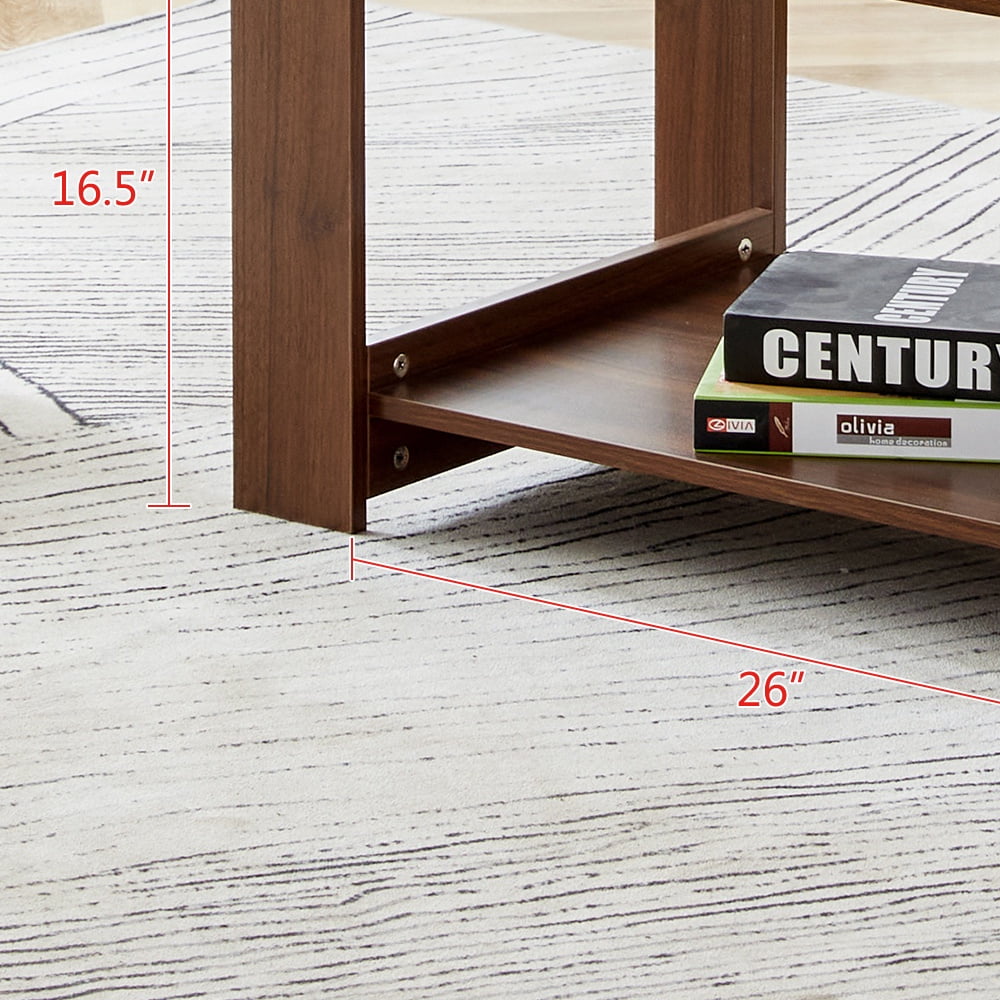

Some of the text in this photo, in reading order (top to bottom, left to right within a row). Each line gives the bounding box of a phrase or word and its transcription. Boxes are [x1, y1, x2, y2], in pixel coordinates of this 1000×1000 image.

[873, 266, 970, 324] CENTURY
[840, 416, 895, 435] olivia
[869, 435, 948, 447] home decoration
